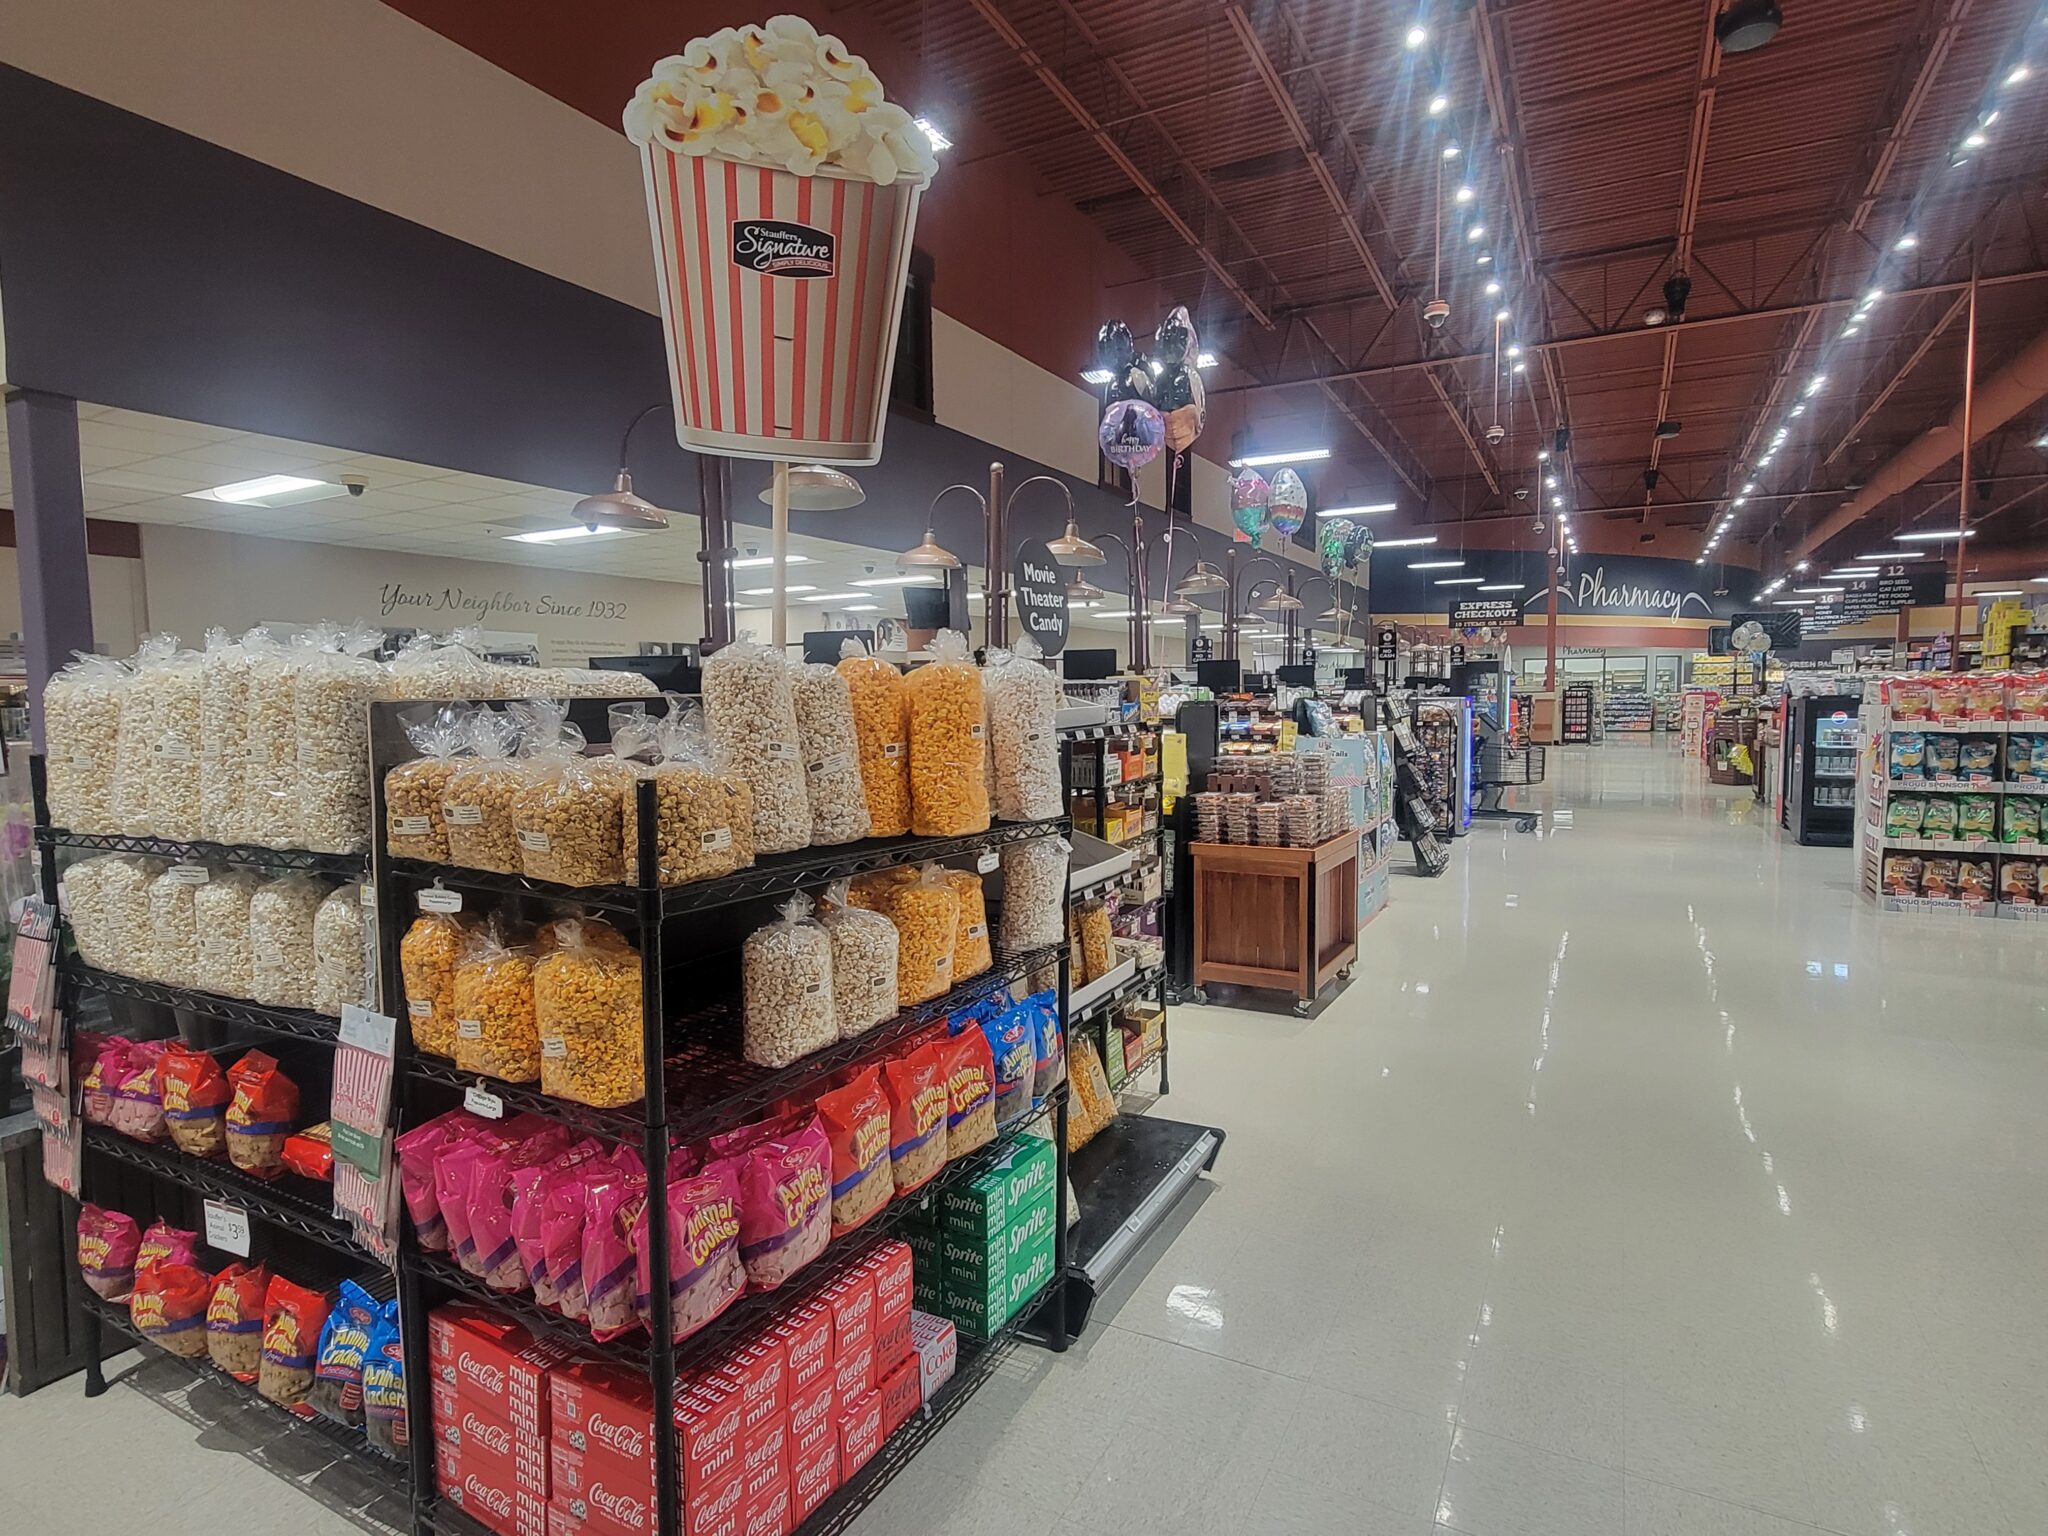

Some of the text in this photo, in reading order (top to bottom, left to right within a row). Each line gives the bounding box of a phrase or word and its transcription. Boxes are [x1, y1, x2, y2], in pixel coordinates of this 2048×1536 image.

[736, 226, 830, 269] Signature
[772, 259, 828, 269] SIMPLY DELICIOUS
[1110, 445, 1152, 453] BIRTHDAY
[1023, 562, 1056, 584] Movie
[1852, 581, 1866, 590] 14
[1887, 566, 1905, 576] 12
[380, 584, 627, 621] Your Neighbor Since 1932
[1020, 587, 1064, 608] Theater
[1460, 601, 1513, 610] EXPRESS
[1578, 567, 1682, 623] Pharmacy
[1821, 595, 1834, 603] 16
[1030, 612, 1063, 636] Candy
[1454, 609, 1518, 619] CHECKOUT
[1562, 645, 1607, 657] Pharmacy
[1890, 898, 1920, 906] PROUD
[1921, 900, 1962, 908] SPONSOR
[2007, 905, 2039, 914] PROUD
[949, 1064, 985, 1094] Animal
[911, 1081, 947, 1118] Animal
[953, 1079, 989, 1112] Crackers
[778, 1162, 823, 1207] Animal
[1008, 1160, 1047, 1206] Sprite
[687, 1197, 733, 1243] Animal
[945, 1193, 983, 1216] Sprite
[949, 1215, 975, 1232] mini
[1008, 1206, 1047, 1255] Sprite
[690, 1220, 740, 1266] Cookies
[945, 1242, 984, 1266] Sprite
[878, 1259, 911, 1298] Coca-Cola
[951, 1266, 977, 1282] mini
[1009, 1251, 1048, 1302] Sprite
[837, 1287, 872, 1330] Coca-Cola
[883, 1287, 906, 1315] mini
[946, 1291, 985, 1315] Sprite
[843, 1318, 867, 1347] mini
[951, 1313, 977, 1330] mini
[789, 1322, 829, 1369] Coca-Cola
[926, 1338, 956, 1377] Coke
[458, 1351, 507, 1394] Coca-Cola
[509, 1364, 538, 1389] mini
[798, 1353, 824, 1384] mini
[837, 1345, 873, 1391] Coca-Cola
[931, 1366, 951, 1390] mini
[509, 1380, 538, 1404] mini
[843, 1376, 867, 1407] mini
[509, 1395, 538, 1420] mini
[510, 1410, 538, 1436] mini
[747, 1392, 776, 1427] mini
[793, 1385, 833, 1434] Coca-Cola
[463, 1412, 512, 1455] Coca-Cola
[515, 1426, 545, 1451] mini
[588, 1412, 645, 1458] Coca-Cola
[691, 1405, 742, 1461] Coca-Cola
[800, 1417, 827, 1451] mini
[846, 1406, 881, 1453] Coca-Cola
[515, 1442, 545, 1466] mini
[701, 1441, 734, 1480] mini
[853, 1436, 876, 1468] mini
[515, 1456, 545, 1482] mini
[516, 1470, 545, 1497] mini
[749, 1459, 779, 1495] mini
[798, 1443, 836, 1495] Coca-Cola
[465, 1473, 513, 1518] Coca-Cola
[516, 1490, 545, 1517] mini
[589, 1482, 647, 1529] Coca-Cola
[694, 1472, 745, 1534] Coca-Cola
[804, 1476, 830, 1511] mini
[516, 1506, 545, 1531] mini
